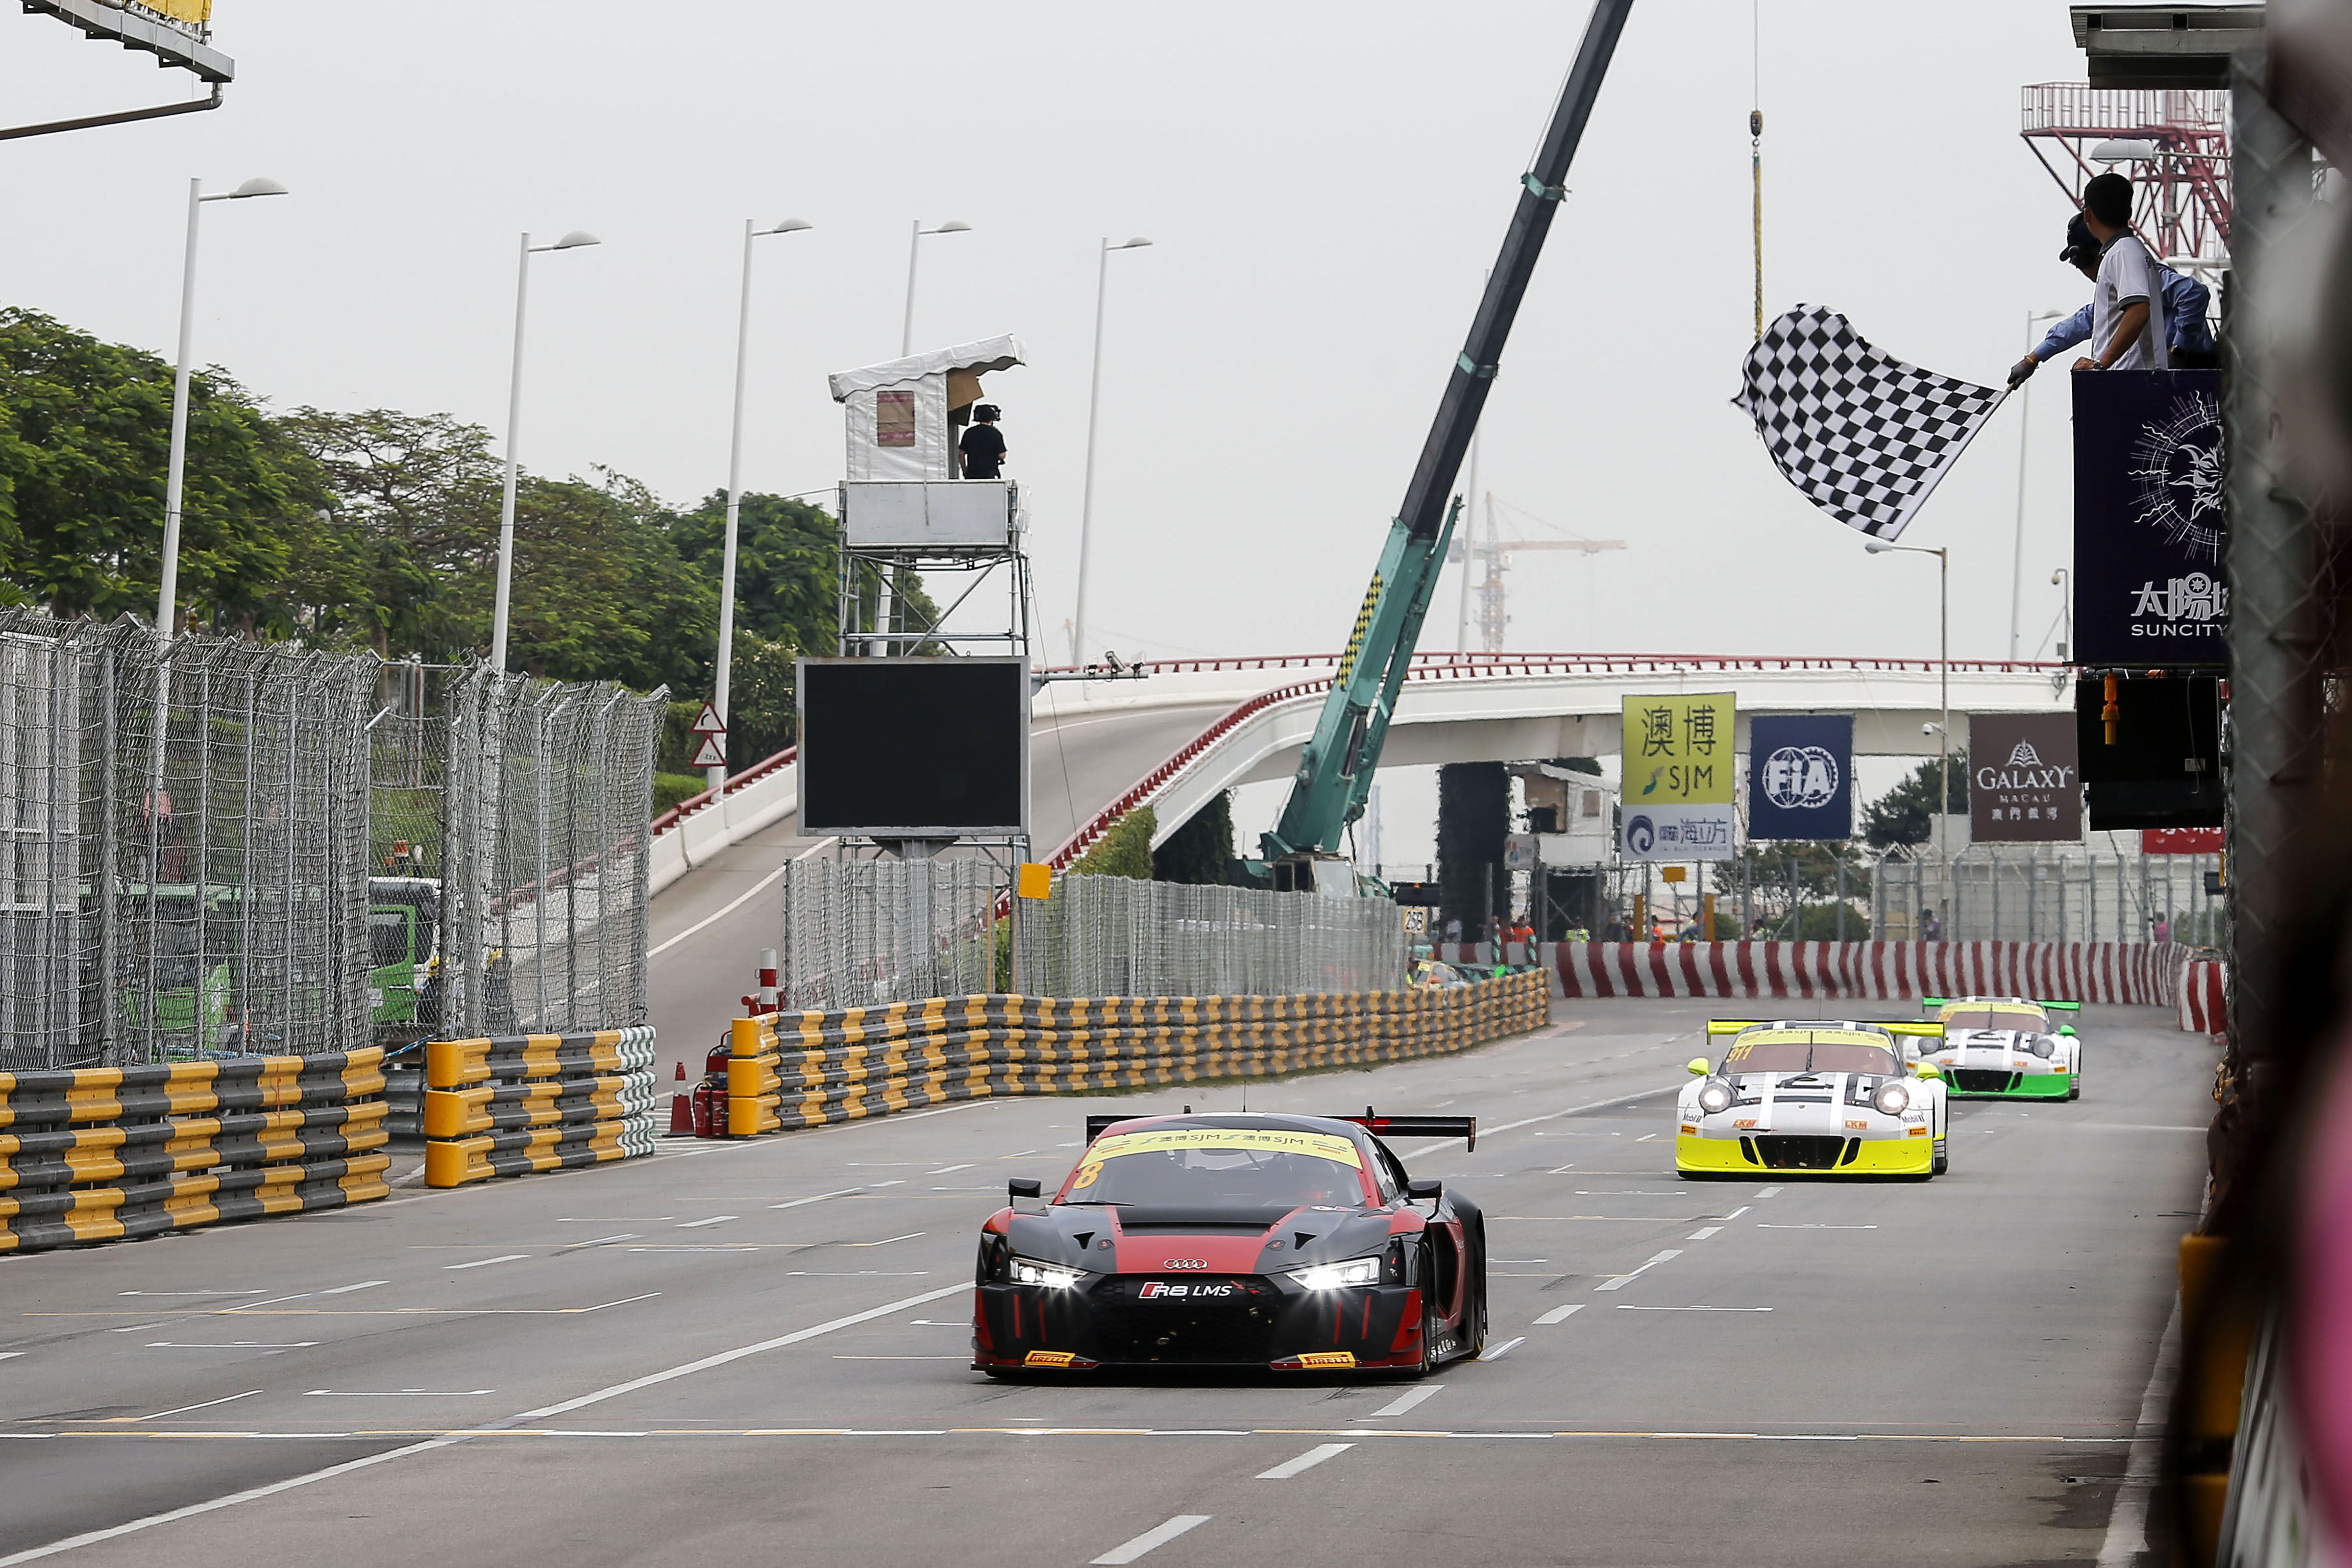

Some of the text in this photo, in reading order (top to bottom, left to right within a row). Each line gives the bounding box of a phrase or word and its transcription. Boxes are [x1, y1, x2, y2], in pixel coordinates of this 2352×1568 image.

[2132, 624, 2228, 637] SUNCITY
[1642, 705, 1716, 757] 澳博
[1669, 765, 1713, 797] SJM
[1977, 765, 2072, 790] GALAXY
[1999, 794, 2051, 804] MACAU
[1726, 1045, 1754, 1063] 911
[1190, 1134, 1220, 1142] SJM
[1273, 1135, 1304, 1146] SJM
[1073, 1161, 1104, 1189] 8
[1150, 1285, 1232, 1297] R8 LMS
[1028, 1352, 1070, 1363] PIRELLI
[1303, 1354, 1349, 1365] PIRELLI
